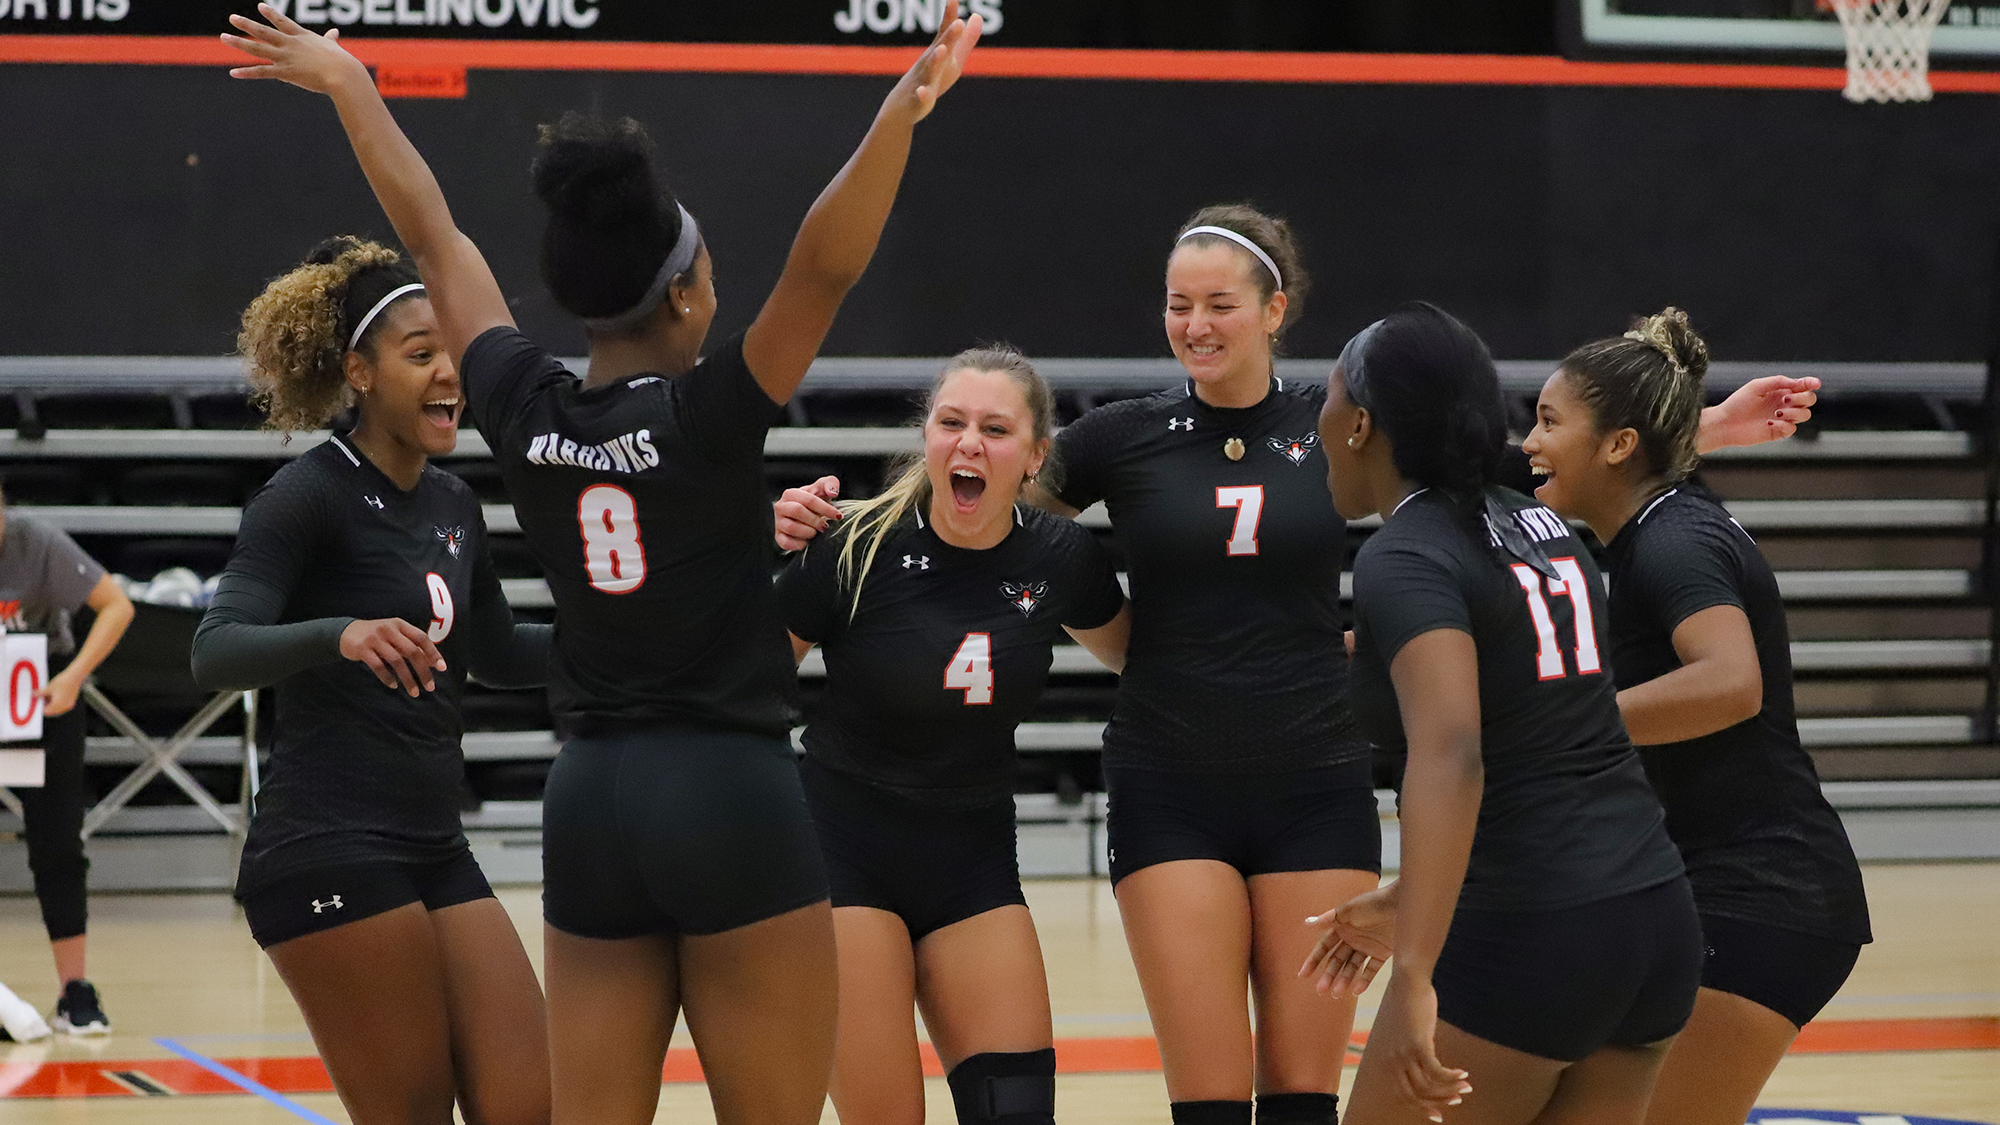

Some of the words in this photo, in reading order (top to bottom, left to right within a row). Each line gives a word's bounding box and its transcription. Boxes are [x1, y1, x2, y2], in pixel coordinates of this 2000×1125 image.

[834, 0, 1004, 35] JONS
[527, 429, 659, 473] WARHAWKS
[577, 483, 648, 595] 8
[1215, 484, 1264, 556] 7
[425, 571, 455, 644] 9
[1509, 556, 1602, 681] 17
[943, 632, 994, 705] 4
